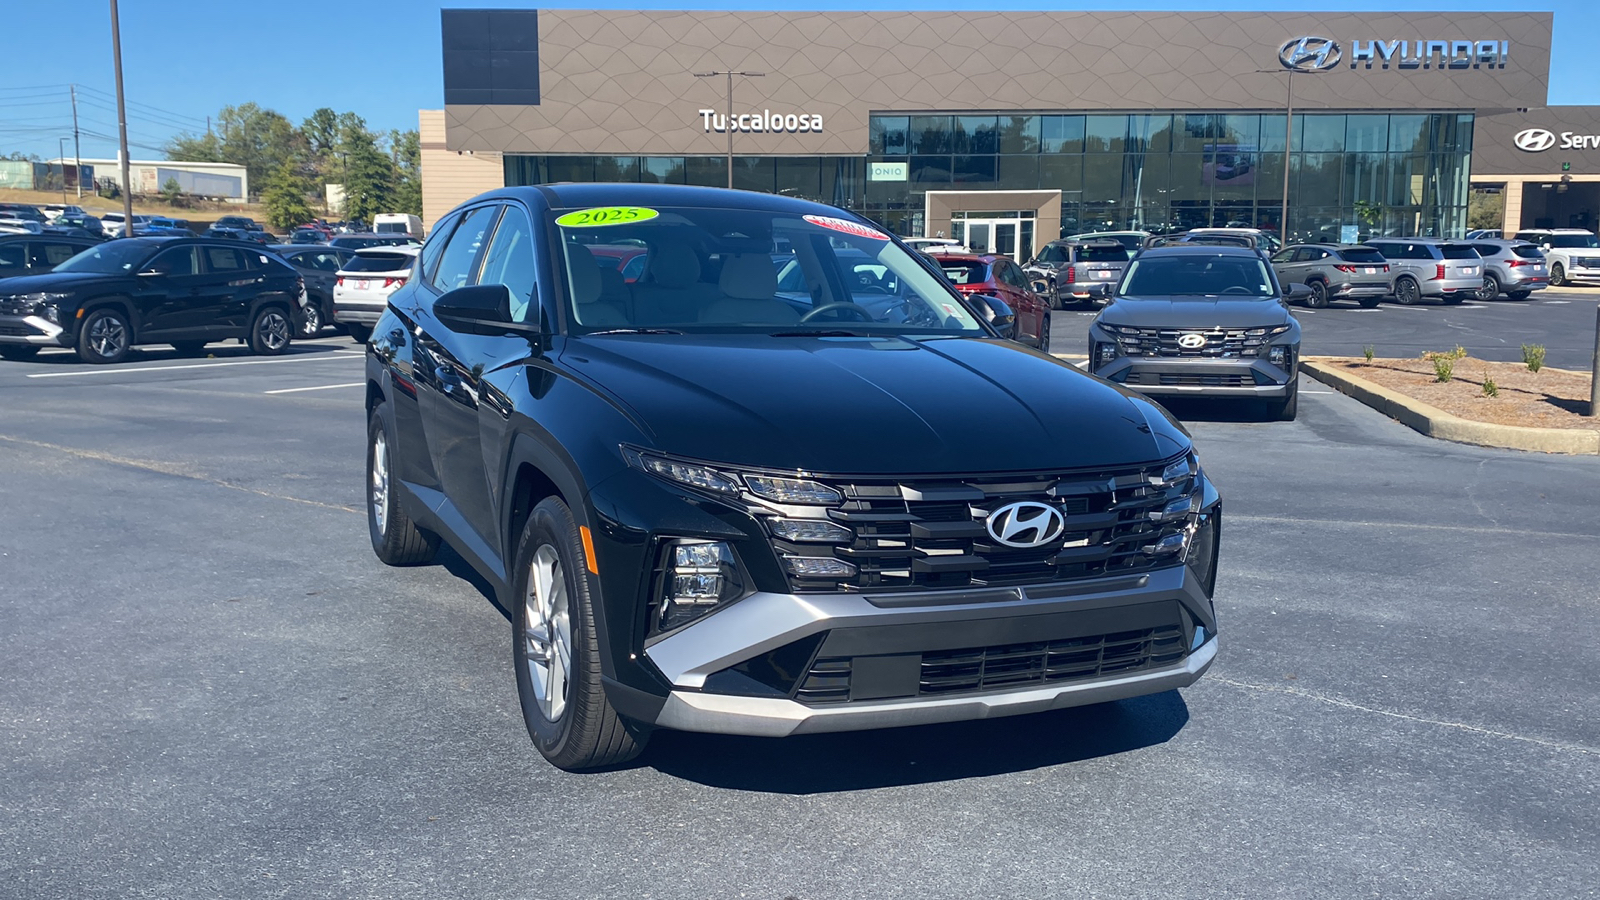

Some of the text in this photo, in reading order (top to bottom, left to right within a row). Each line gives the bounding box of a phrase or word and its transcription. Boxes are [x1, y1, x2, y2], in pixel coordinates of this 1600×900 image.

[1350, 40, 1509, 67] HYUNDAI
[698, 109, 824, 132] Tuscaloosa
[1559, 131, 1600, 149] Serv
[870, 167, 902, 176] IONIQ
[577, 208, 639, 224] 2025
